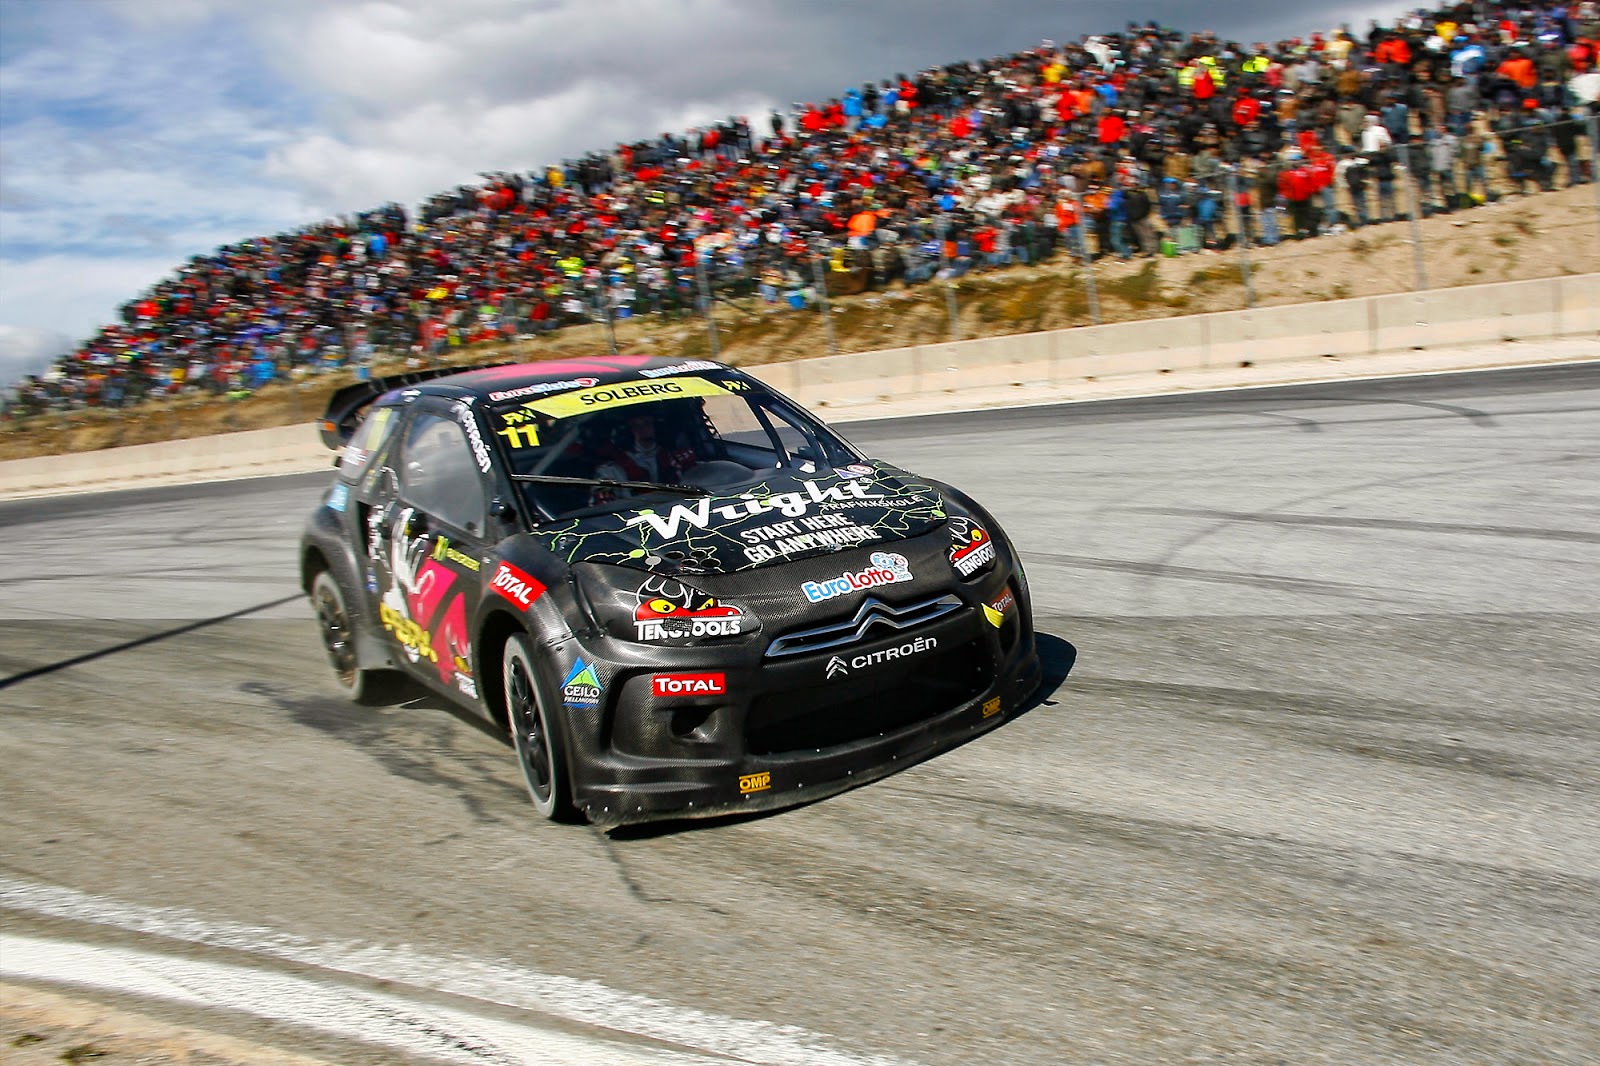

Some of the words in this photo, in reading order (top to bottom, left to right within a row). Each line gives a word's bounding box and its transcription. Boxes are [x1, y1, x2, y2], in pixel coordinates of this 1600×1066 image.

[579, 382, 683, 405] SOLBERG
[497, 424, 540, 449] 11
[626, 478, 885, 540] Wright
[818, 493, 924, 512] TRAFIKKSKOLE
[740, 520, 802, 544] START
[799, 512, 855, 531] HERE
[743, 544, 776, 563] GO
[774, 525, 883, 555] ANYWHERE
[491, 565, 533, 605] TOTAL
[991, 593, 1012, 612] TOTAL
[563, 685, 600, 698] GEILO
[655, 677, 722, 693] TOTAL
[739, 776, 771, 791] OMP
